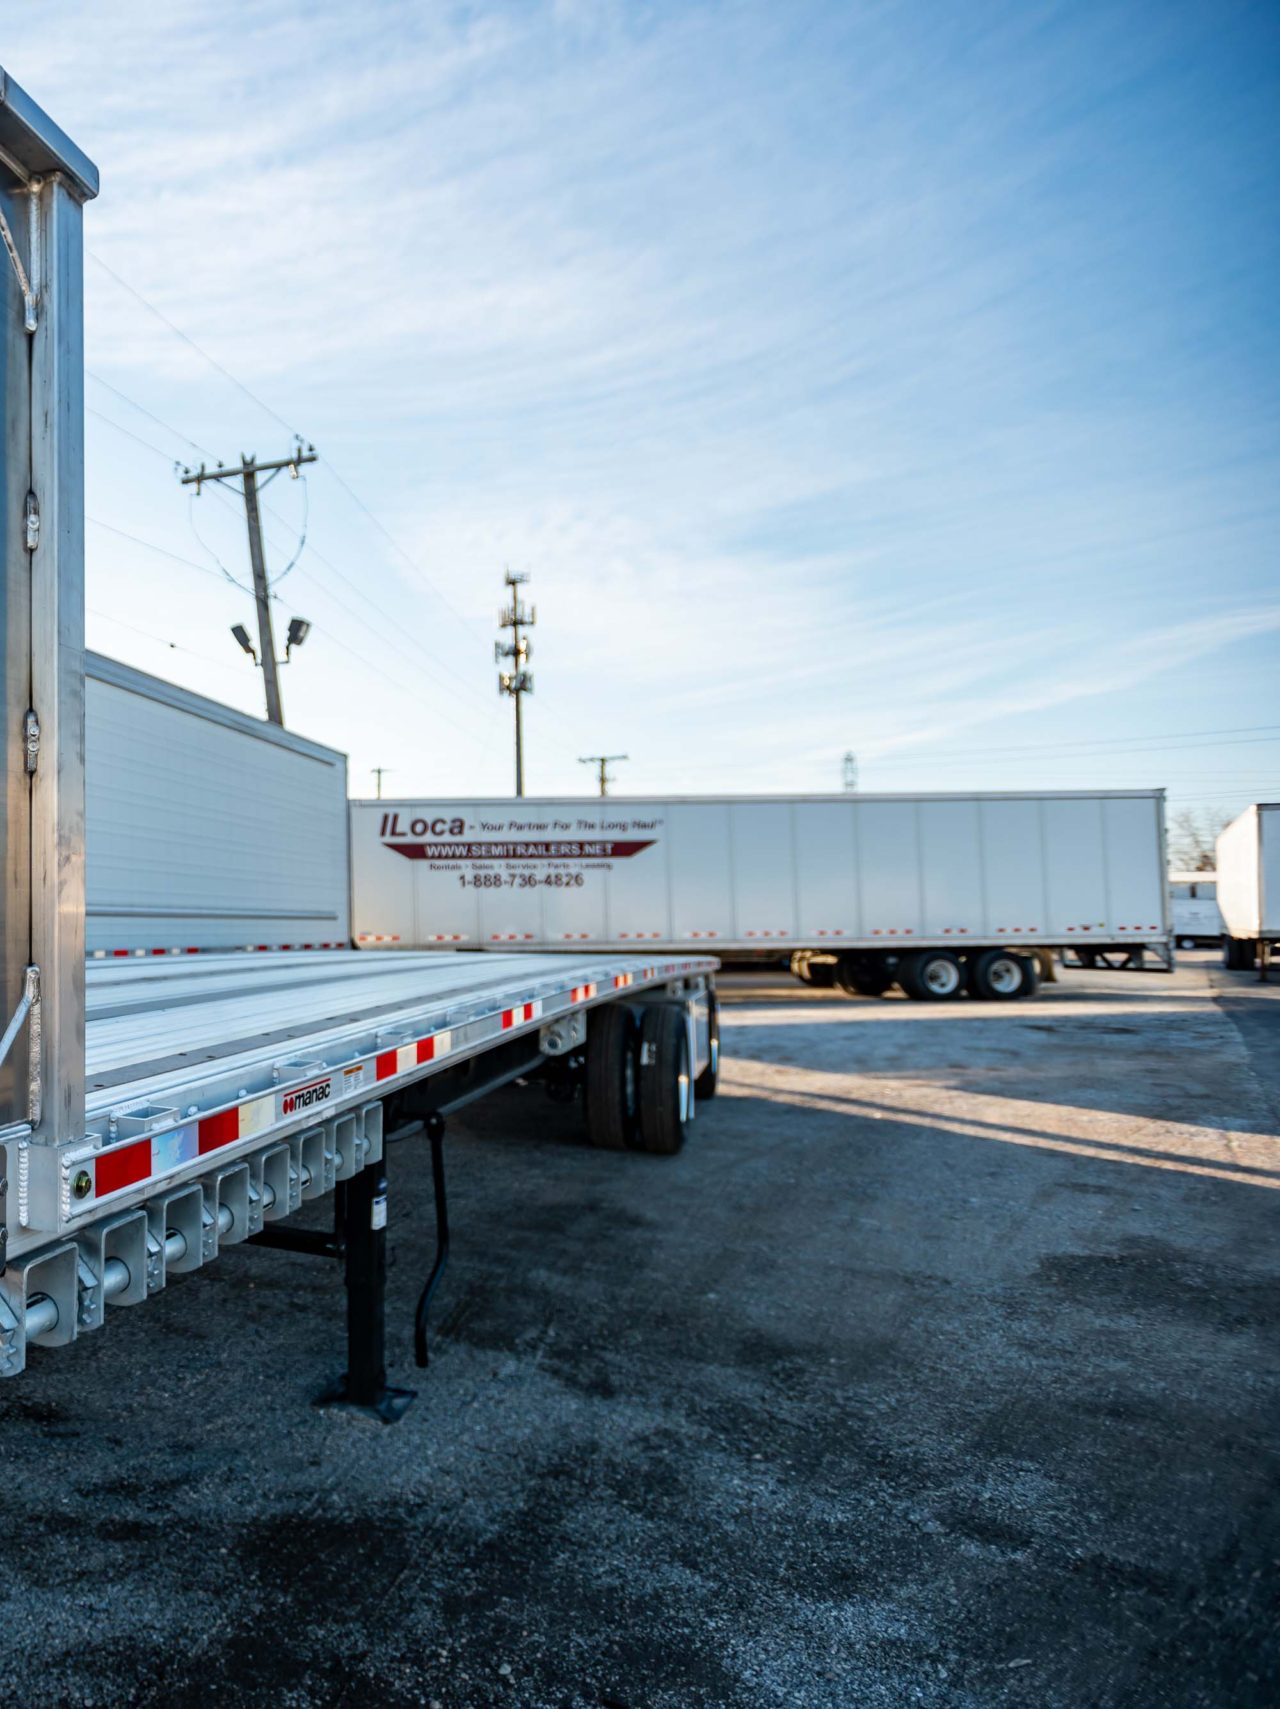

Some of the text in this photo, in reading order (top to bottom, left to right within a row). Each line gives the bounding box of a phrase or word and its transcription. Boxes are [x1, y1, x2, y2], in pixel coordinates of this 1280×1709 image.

[380, 812, 466, 838] ILoca
[480, 821, 505, 832] Your
[508, 820, 549, 832] Partner
[553, 820, 572, 831] For
[576, 819, 597, 830] The
[600, 819, 629, 832] Long
[426, 843, 614, 858] WWW.SEMITRAILERS.NET
[429, 863, 463, 871] Rentals
[471, 863, 494, 871] Sales
[506, 862, 538, 871] Service
[458, 872, 585, 889] 1-888-736-4826
[294, 1083, 331, 1110] manac
